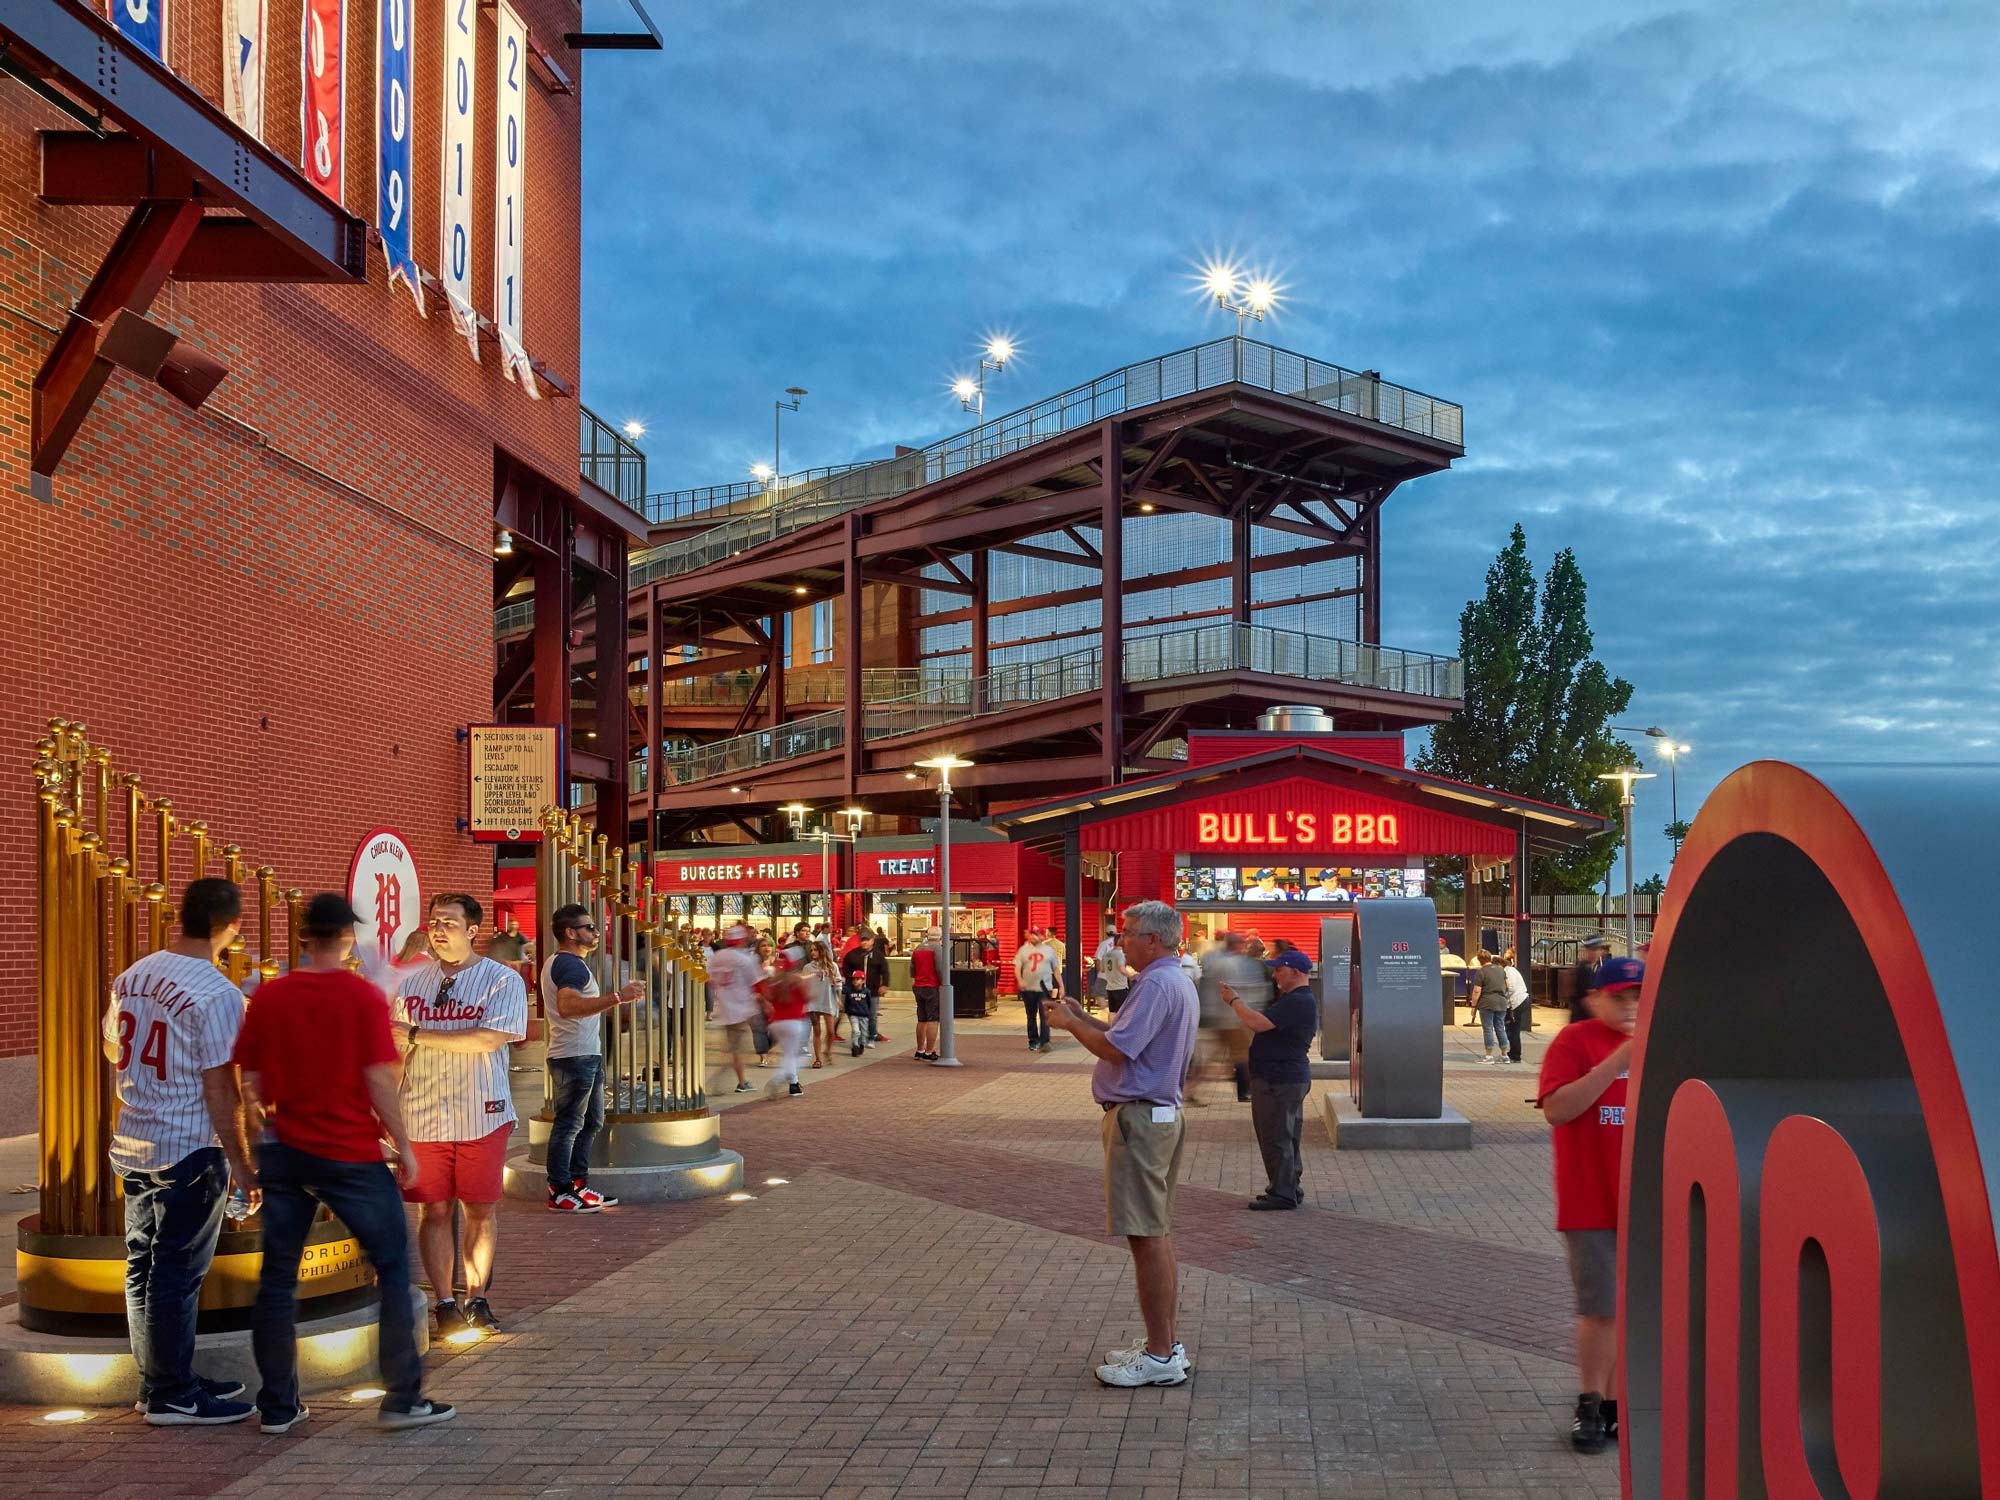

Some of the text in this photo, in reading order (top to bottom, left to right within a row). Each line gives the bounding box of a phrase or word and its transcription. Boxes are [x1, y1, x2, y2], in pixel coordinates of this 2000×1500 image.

[506, 34, 518, 327] 2011
[523, 745, 534, 753] ALL
[1199, 811, 1399, 845] BULL'S BBQ
[681, 865, 741, 881] BURGERS
[759, 862, 799, 879] FRIES
[1391, 941, 1409, 953] 36
[404, 995, 485, 1023] Phillies
[117, 1011, 167, 1081] 34
